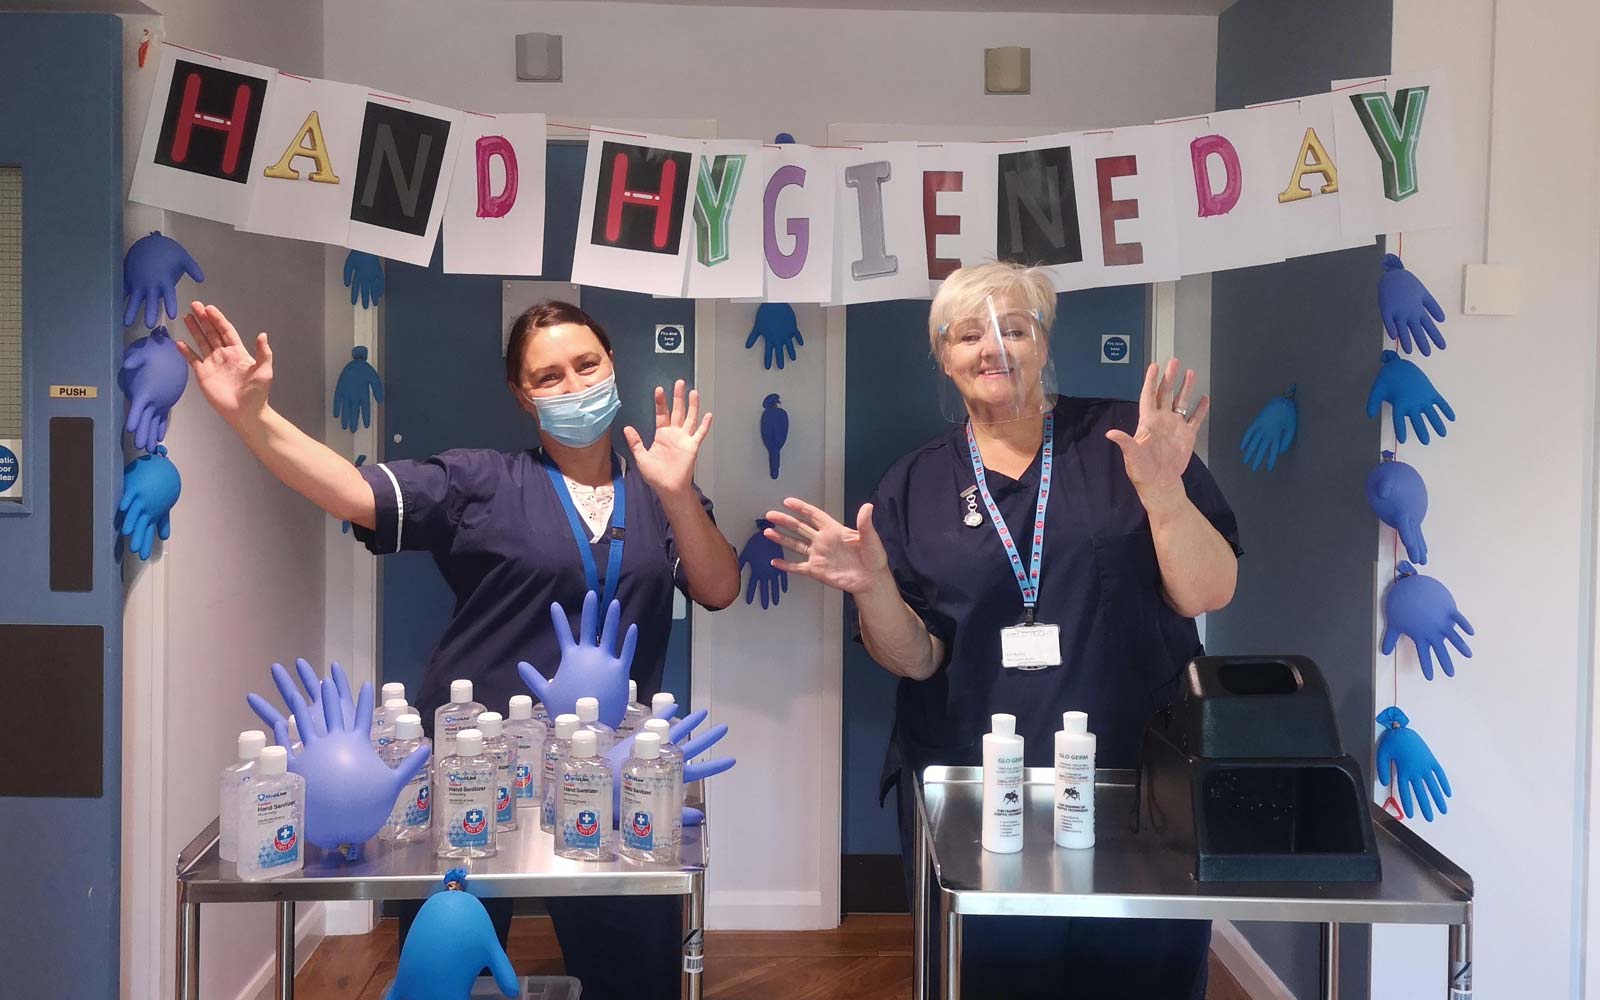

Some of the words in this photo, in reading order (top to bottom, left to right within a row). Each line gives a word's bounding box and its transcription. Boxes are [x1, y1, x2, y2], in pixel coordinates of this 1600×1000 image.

[171, 73, 519, 219] HAND
[604, 153, 1144, 281] HYGIENE
[1189, 86, 1430, 218] DAY
[60, 387, 87, 396] PUSH
